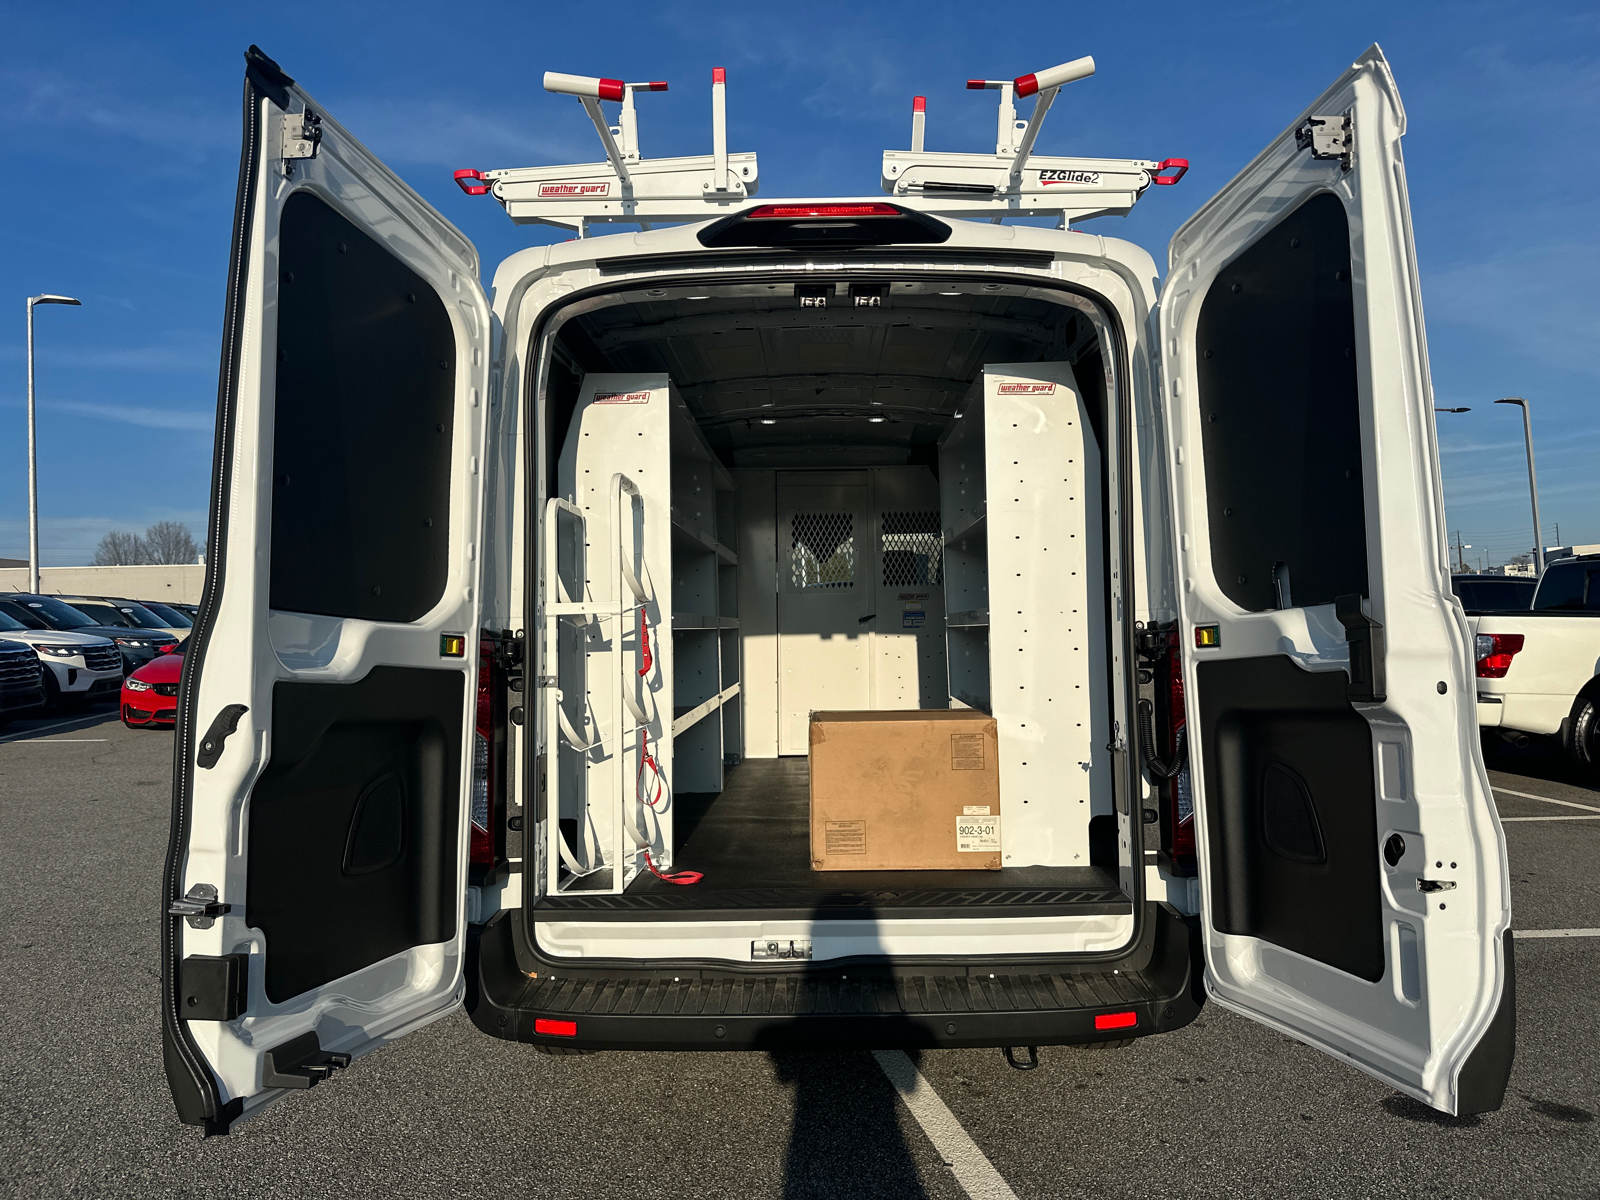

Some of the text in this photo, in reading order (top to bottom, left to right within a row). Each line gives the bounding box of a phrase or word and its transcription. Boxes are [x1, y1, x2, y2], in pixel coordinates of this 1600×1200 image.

[1039, 170, 1099, 184] EZGlide2
[542, 184, 606, 195] weather guard
[1001, 383, 1031, 391] weather
[1032, 384, 1054, 393] guard
[626, 393, 647, 401] guard
[959, 825, 995, 835] 902-3-01
